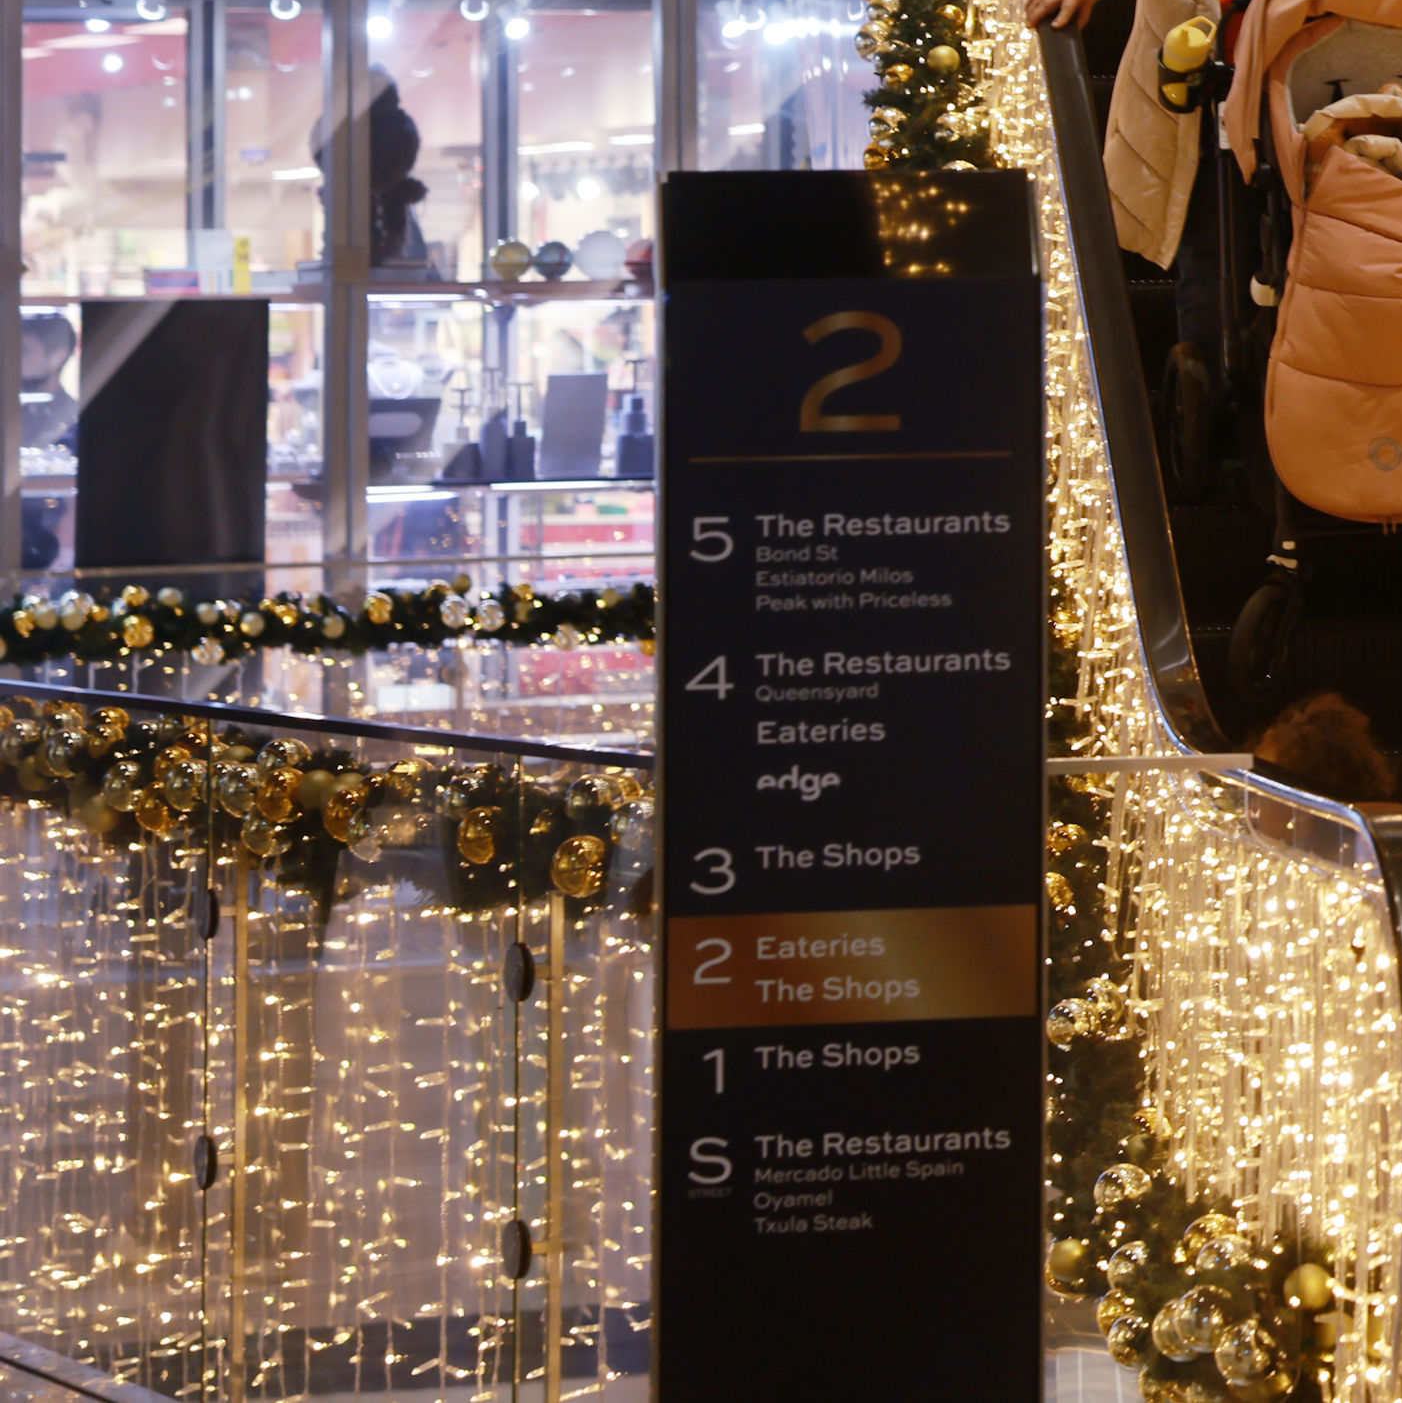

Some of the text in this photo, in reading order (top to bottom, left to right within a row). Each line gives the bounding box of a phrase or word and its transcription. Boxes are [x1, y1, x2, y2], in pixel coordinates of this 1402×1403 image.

[799, 310, 903, 433] 2
[689, 510, 1011, 563] 5 The Restaurants
[755, 543, 838, 563] Bond St
[755, 567, 915, 588] Estiatorio Milos
[755, 591, 953, 612] Peak with Priceless
[684, 648, 1012, 700] 4 The Restaurants
[754, 681, 880, 703] Queensyard
[757, 717, 886, 745] Eateries
[756, 764, 841, 802] edge
[689, 842, 921, 895] 3 The Shops
[693, 932, 887, 985] 2 Eateries
[755, 975, 922, 1005] The Shops
[703, 1041, 921, 1095] 1 The Shops
[688, 1126, 1012, 1185] S The Restaurants
[753, 1159, 965, 1184] Mercado Little Spain
[753, 1188, 833, 1212] Oyamel
[753, 1212, 873, 1234] Txula Steak
